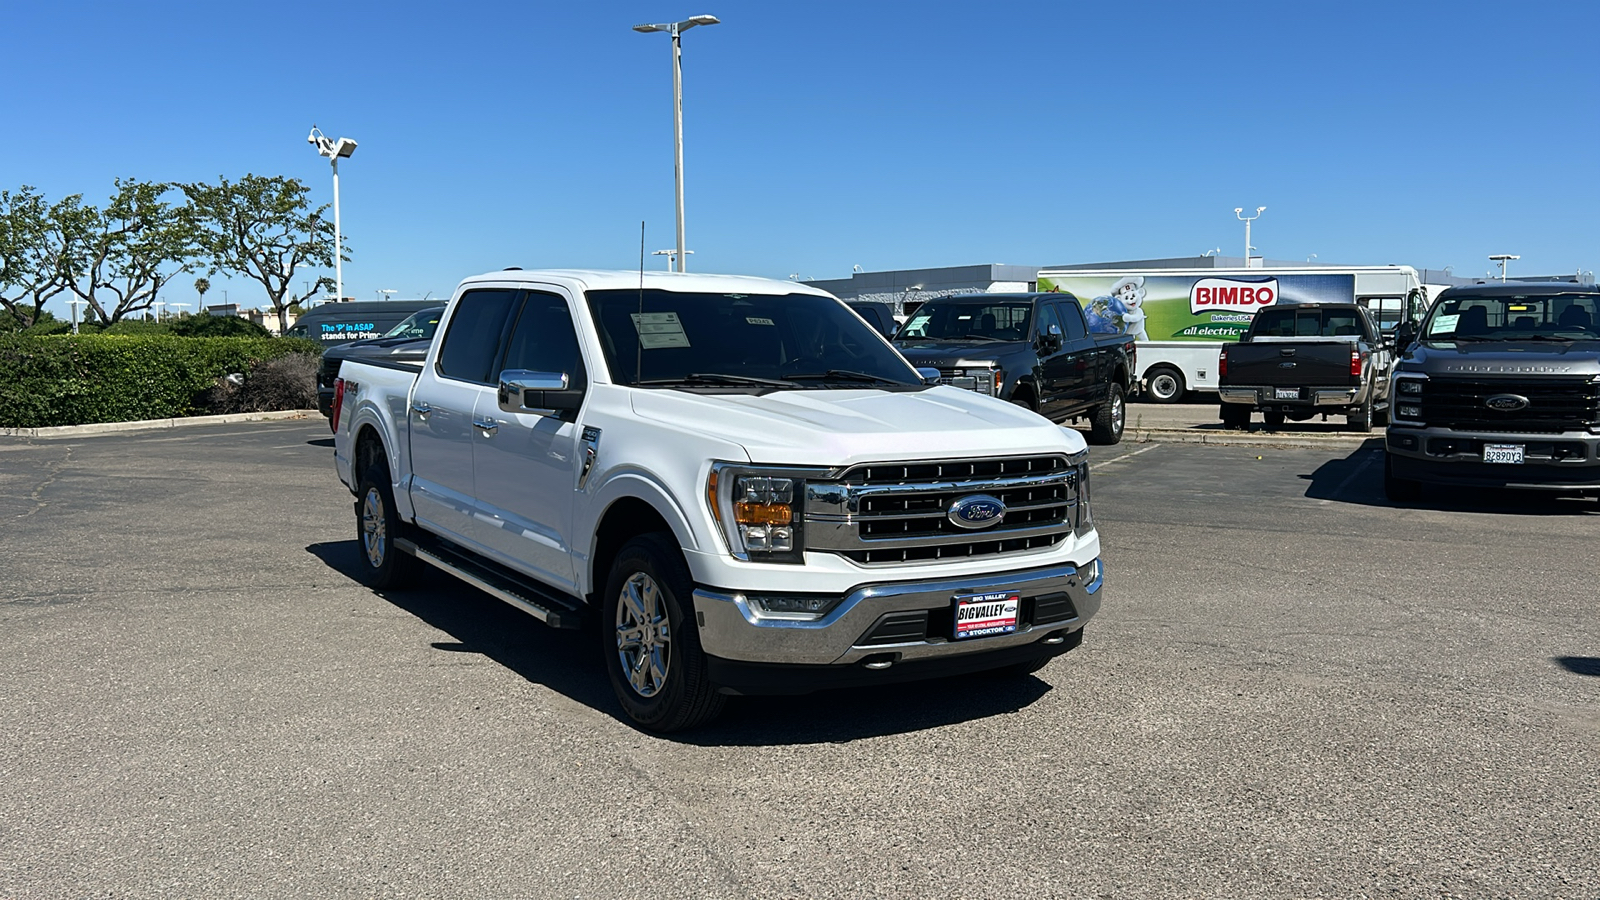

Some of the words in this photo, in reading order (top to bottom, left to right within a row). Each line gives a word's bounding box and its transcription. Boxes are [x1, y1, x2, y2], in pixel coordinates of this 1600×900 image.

[1195, 286, 1274, 305] BIMBO
[354, 323, 375, 331] ASAP
[1183, 326, 1197, 335] all
[1198, 326, 1238, 335] electric
[346, 331, 358, 339] for
[1494, 399, 1518, 408] Ford
[967, 504, 995, 519] Ford
[984, 593, 1007, 601] VALLEY
[969, 627, 1004, 636] STOCKTON
